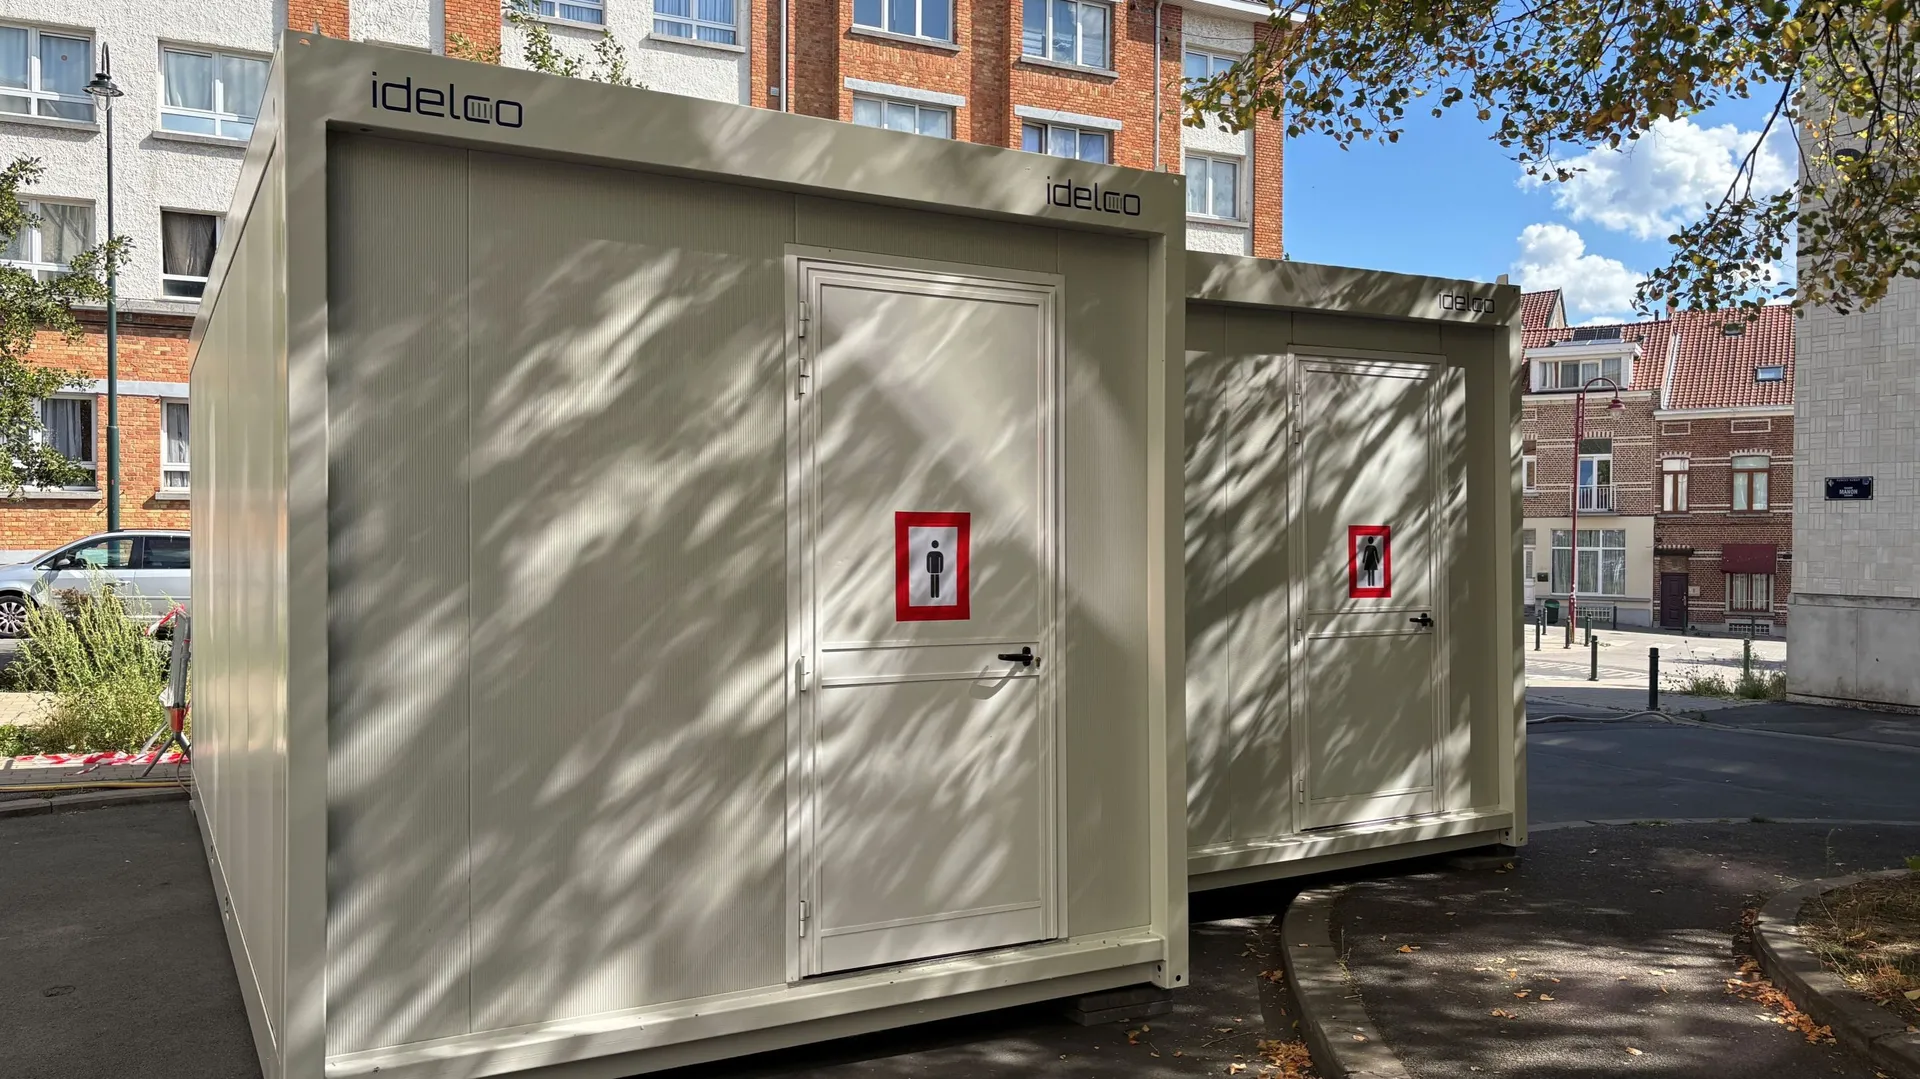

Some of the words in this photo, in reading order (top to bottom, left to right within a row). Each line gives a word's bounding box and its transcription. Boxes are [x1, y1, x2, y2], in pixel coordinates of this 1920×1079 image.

[372, 71, 522, 128] idelco
[1047, 176, 1140, 216] idelco
[1439, 289, 1495, 313] idelco
